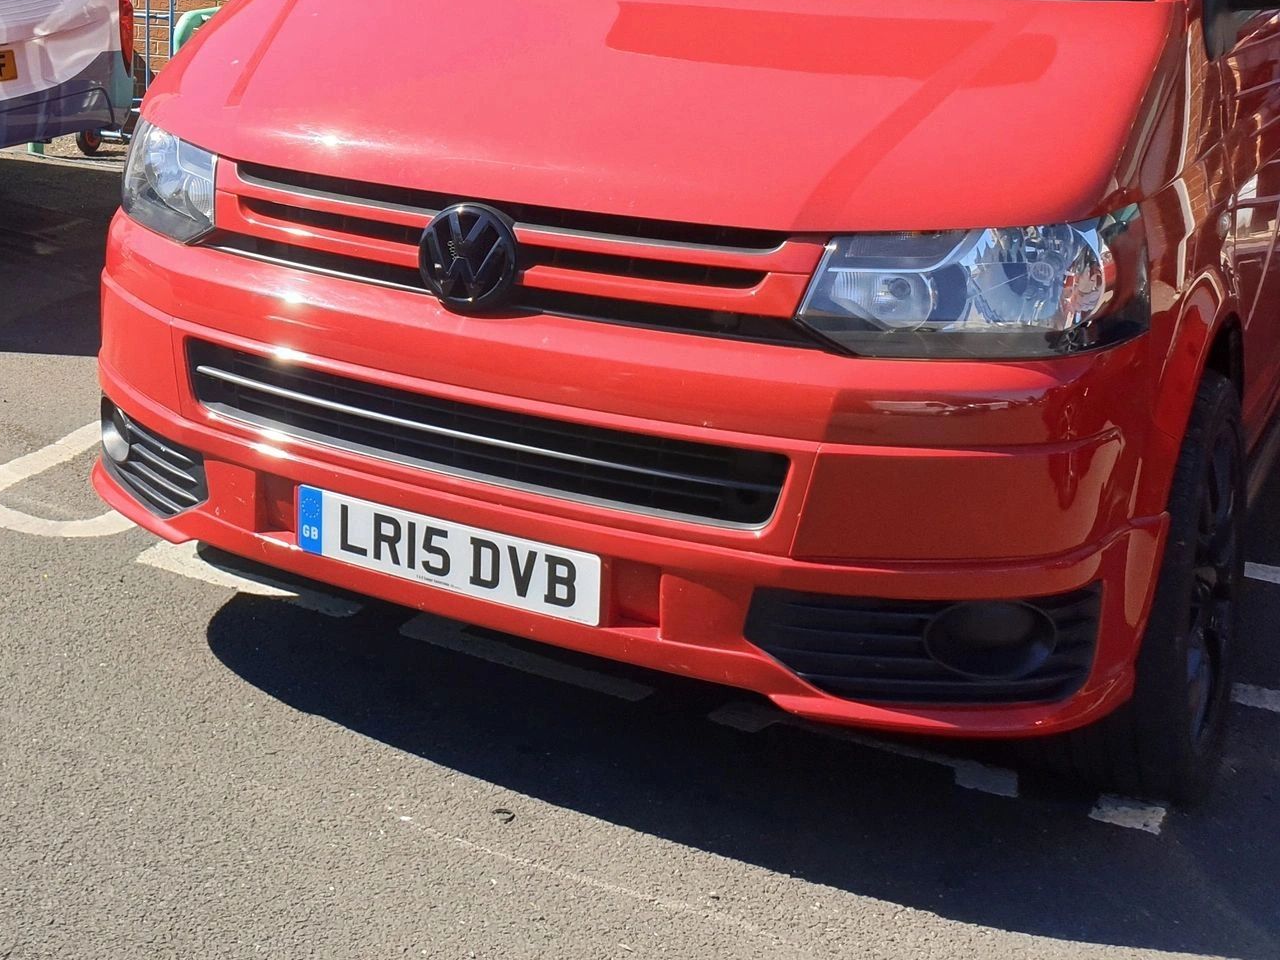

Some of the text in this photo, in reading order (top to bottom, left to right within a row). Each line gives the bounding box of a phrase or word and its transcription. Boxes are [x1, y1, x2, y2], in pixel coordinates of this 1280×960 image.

[303, 524, 318, 540] GB
[340, 504, 577, 607] LR15 DVB
